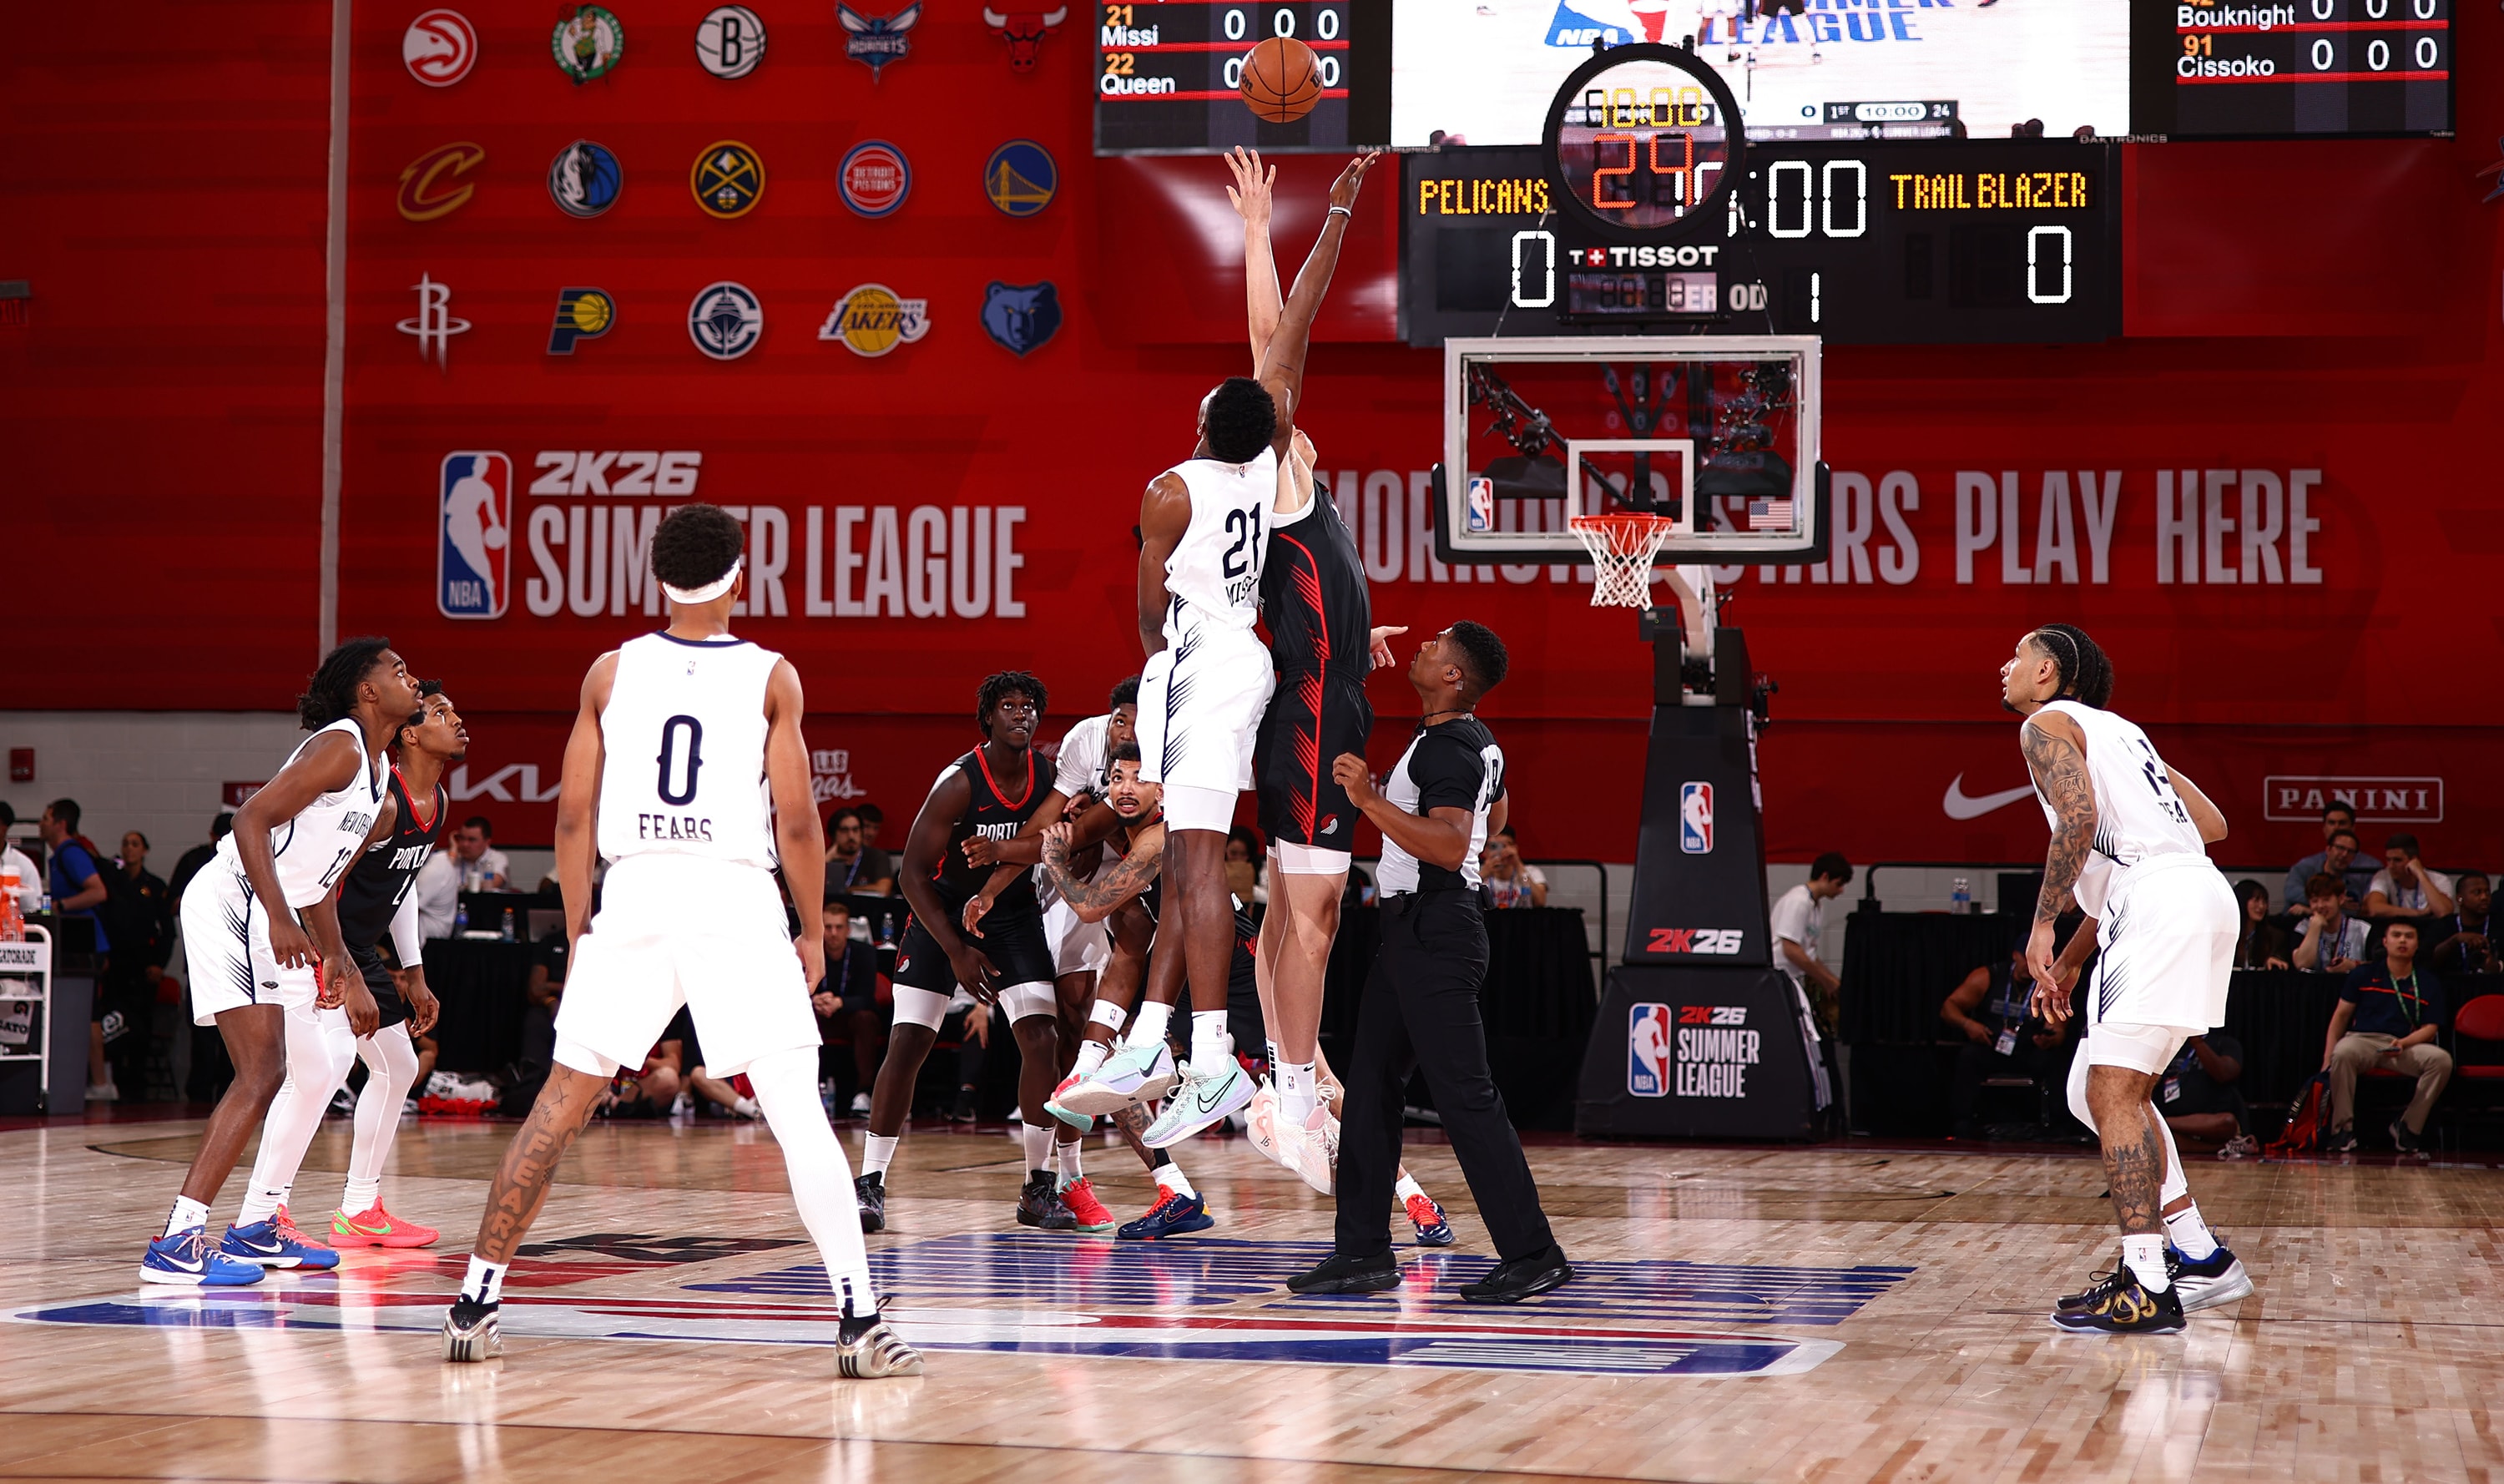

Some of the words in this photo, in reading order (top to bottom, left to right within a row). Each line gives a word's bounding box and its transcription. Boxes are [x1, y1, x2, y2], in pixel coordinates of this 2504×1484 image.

[1106, 5, 1133, 26] 21
[1224, 8, 1246, 40] 0
[1274, 8, 1296, 38] 0
[1317, 8, 1340, 40] 0
[2178, 5, 2295, 30] Bouknight
[722, 18, 742, 67] B
[1101, 25, 1159, 47] Missi
[2183, 34, 2214, 57] 91
[1105, 53, 1134, 74] 22
[2178, 54, 2275, 78] Cissoko
[2311, 39, 2334, 70] 0
[2368, 40, 2390, 71] 0
[2415, 37, 2438, 68] 0
[1100, 73, 1175, 96] Queen
[1600, 86, 1702, 128] 10:00
[1865, 105, 1920, 119] 10:00
[1932, 103, 1951, 118] 24
[1593, 132, 1693, 209] 24
[1420, 179, 1549, 215] PELICANS
[1890, 173, 1971, 209] TRAIL
[1977, 172, 2086, 208] BLAZER
[1512, 230, 1556, 308] 0
[1609, 245, 1719, 268] TISSOT
[2027, 225, 2072, 304] 0
[1810, 272, 1820, 323] 1
[830, 304, 918, 339] LAKERS
[529, 451, 702, 497] 2K26
[1223, 502, 1261, 579] 21
[1955, 470, 2123, 585] PLAY
[2157, 469, 2323, 585] HERE
[525, 506, 789, 618] SUMER
[805, 506, 1027, 618] LEAGUE
[448, 581, 482, 609] NBA
[656, 714, 704, 807] 0
[2279, 788, 2429, 811] PANINI
[639, 814, 713, 842] FEARS
[318, 846, 352, 889] 12
[1646, 927, 1744, 955] 2K26
[1679, 1006, 1747, 1025] 2K26
[1677, 1027, 1760, 1064] SUMMER
[1634, 1074, 1655, 1091] NBA
[1676, 1063, 1746, 1098] LEAGUE
